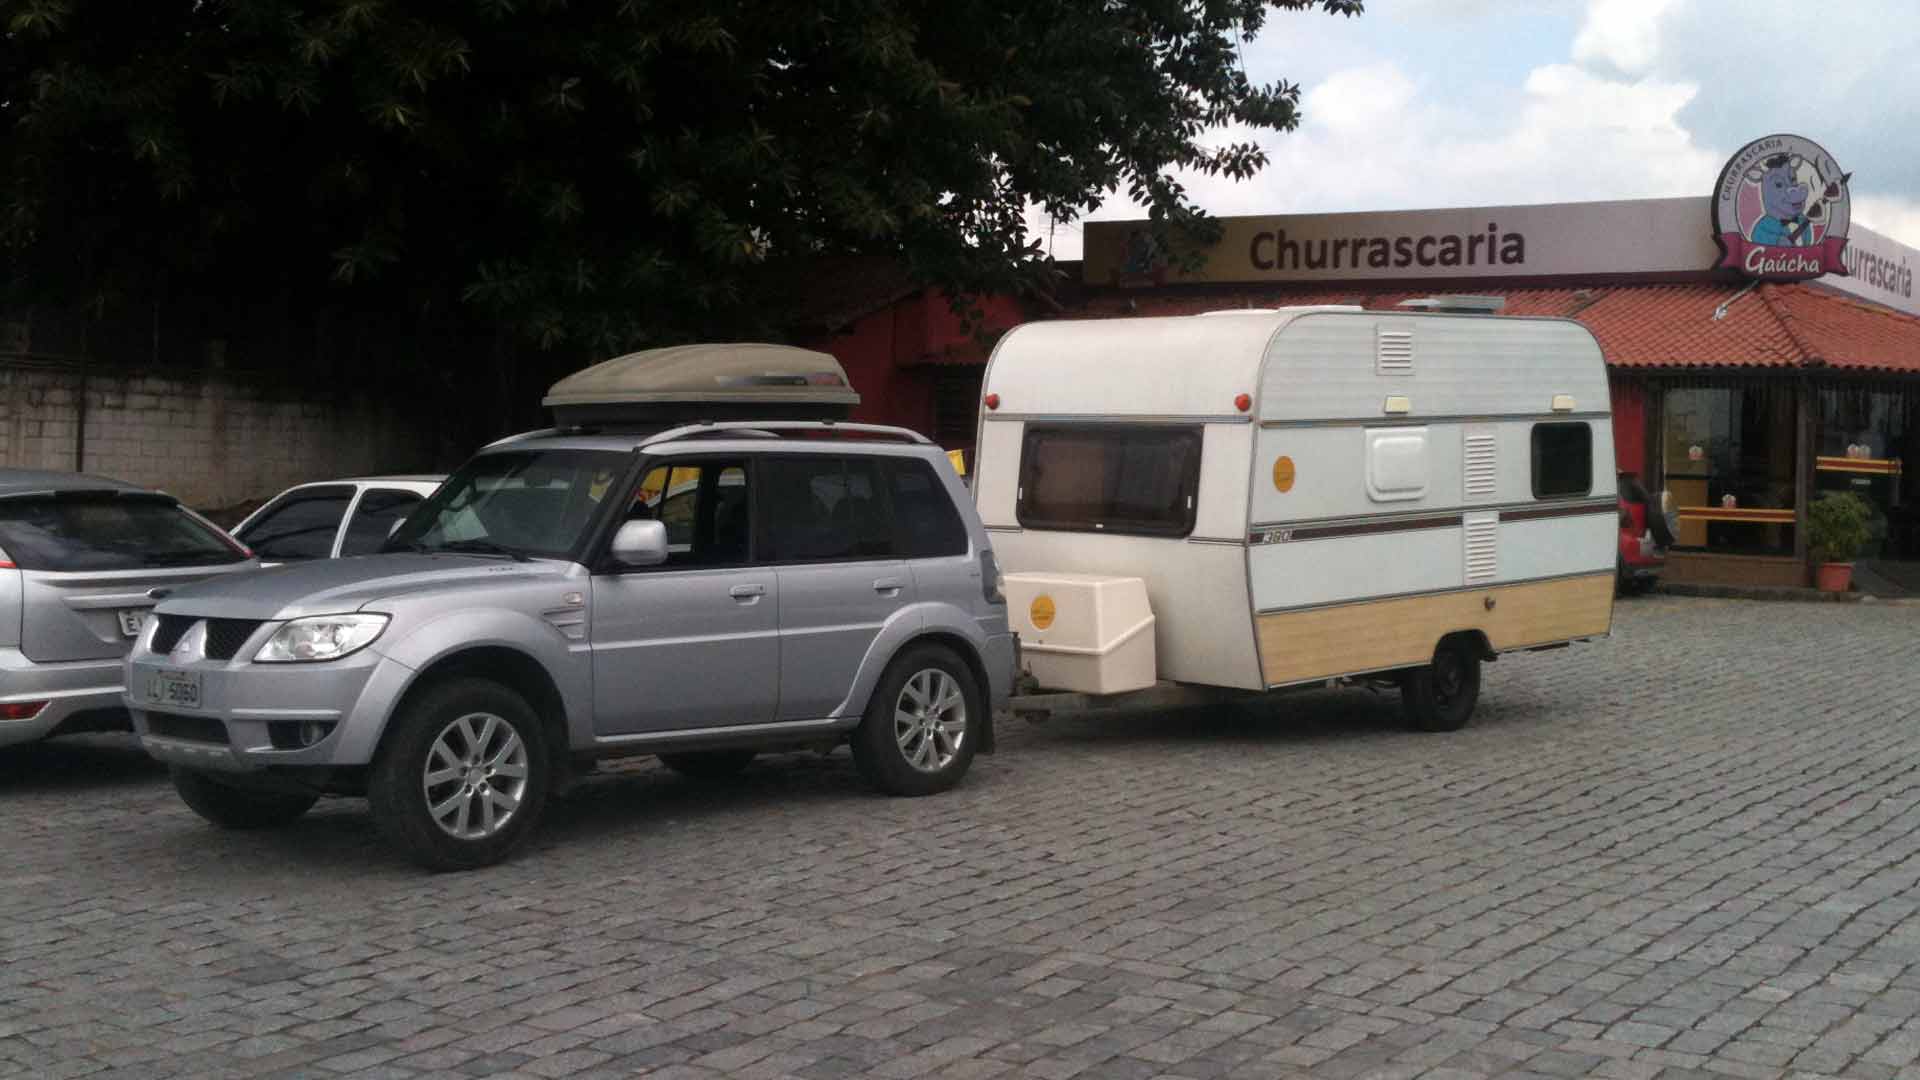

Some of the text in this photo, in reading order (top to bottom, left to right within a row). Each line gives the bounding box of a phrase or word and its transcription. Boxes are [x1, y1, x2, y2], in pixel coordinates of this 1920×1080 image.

[1722, 139, 1783, 201] CHURRASCARIA
[1249, 222, 1526, 271] Churrascaria
[1745, 246, 1820, 274] Gaúcha
[1845, 245, 1912, 298] urrascaria
